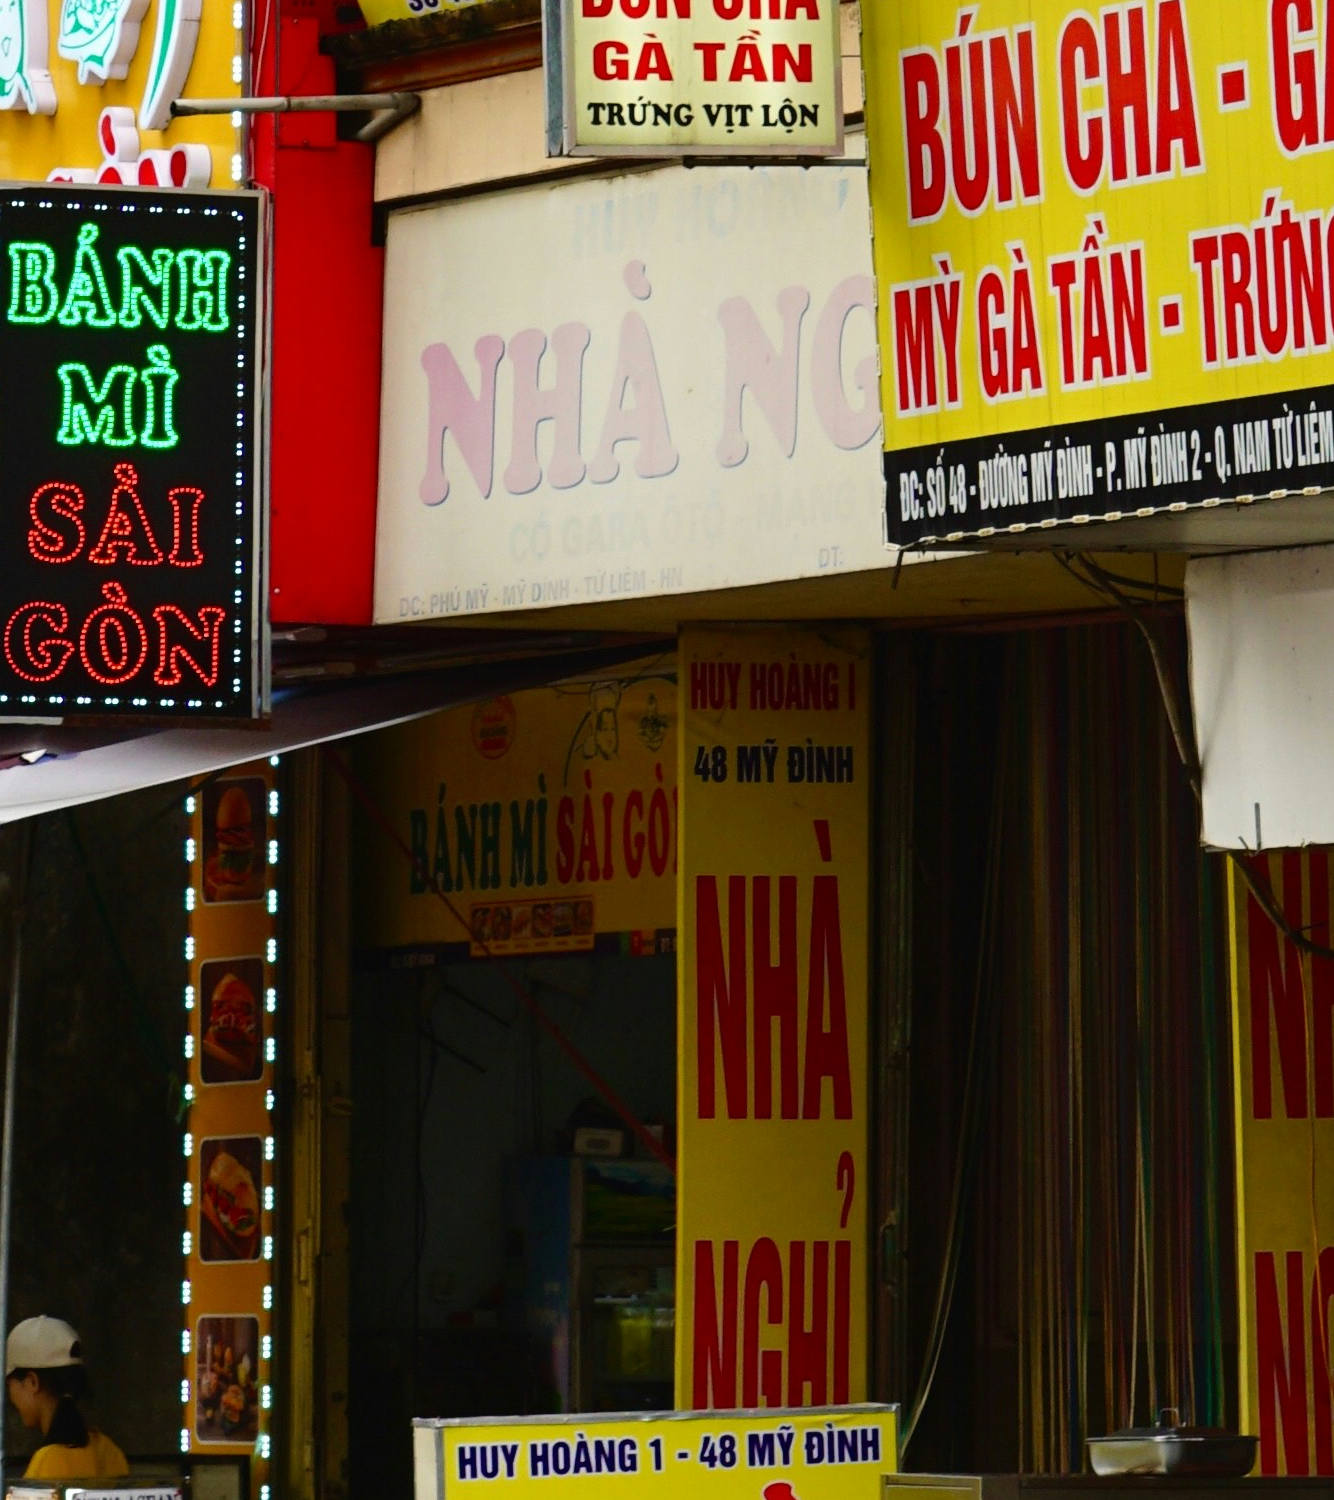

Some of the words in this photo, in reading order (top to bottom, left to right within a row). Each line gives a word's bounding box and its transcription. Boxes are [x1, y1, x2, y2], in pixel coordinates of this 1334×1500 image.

[592, 29, 673, 82] GÀ
[694, 29, 812, 82] TẦN
[589, 95, 693, 128] TRỨNG
[703, 101, 753, 135] VỊT
[761, 96, 820, 135] LỘN
[904, 7, 1043, 227] BÚN
[6, 223, 231, 331] BÁNH
[56, 344, 180, 450] MÌ
[419, 260, 679, 506] NHÀ
[900, 468, 923, 521] ĐC:
[926, 448, 946, 518] SỐ
[949, 462, 966, 513] 48
[979, 453, 1027, 509] ĐƯỜNG
[1030, 442, 1054, 503] MỸ
[1056, 442, 1092, 499] ĐÌNH
[1106, 441, 1121, 493] P.
[1125, 428, 1148, 488] MỸ
[1151, 422, 1188, 485] ĐÌNH
[1191, 432, 1202, 481] 2
[1216, 429, 1229, 484] Q.
[1235, 422, 1270, 474] NAM
[1273, 402, 1293, 471] TỪ
[1296, 400, 1333, 465] LIÊM
[26, 462, 206, 569] SÀI
[4, 580, 225, 688] GÒN
[691, 662, 743, 710] HUY
[750, 649, 840, 709] HOÀNG
[694, 745, 727, 783] 48
[737, 737, 778, 782] MỸ
[786, 739, 853, 784] ĐÌNH
[696, 820, 853, 1120] NHÀ
[458, 1445, 518, 1480] HUY
[530, 1434, 639, 1477] HOÀNG
[648, 1440, 664, 1473] 1
[699, 1436, 737, 1470] 48
[747, 1425, 795, 1467] MỸ
[803, 1424, 880, 1466] ĐÌNH
